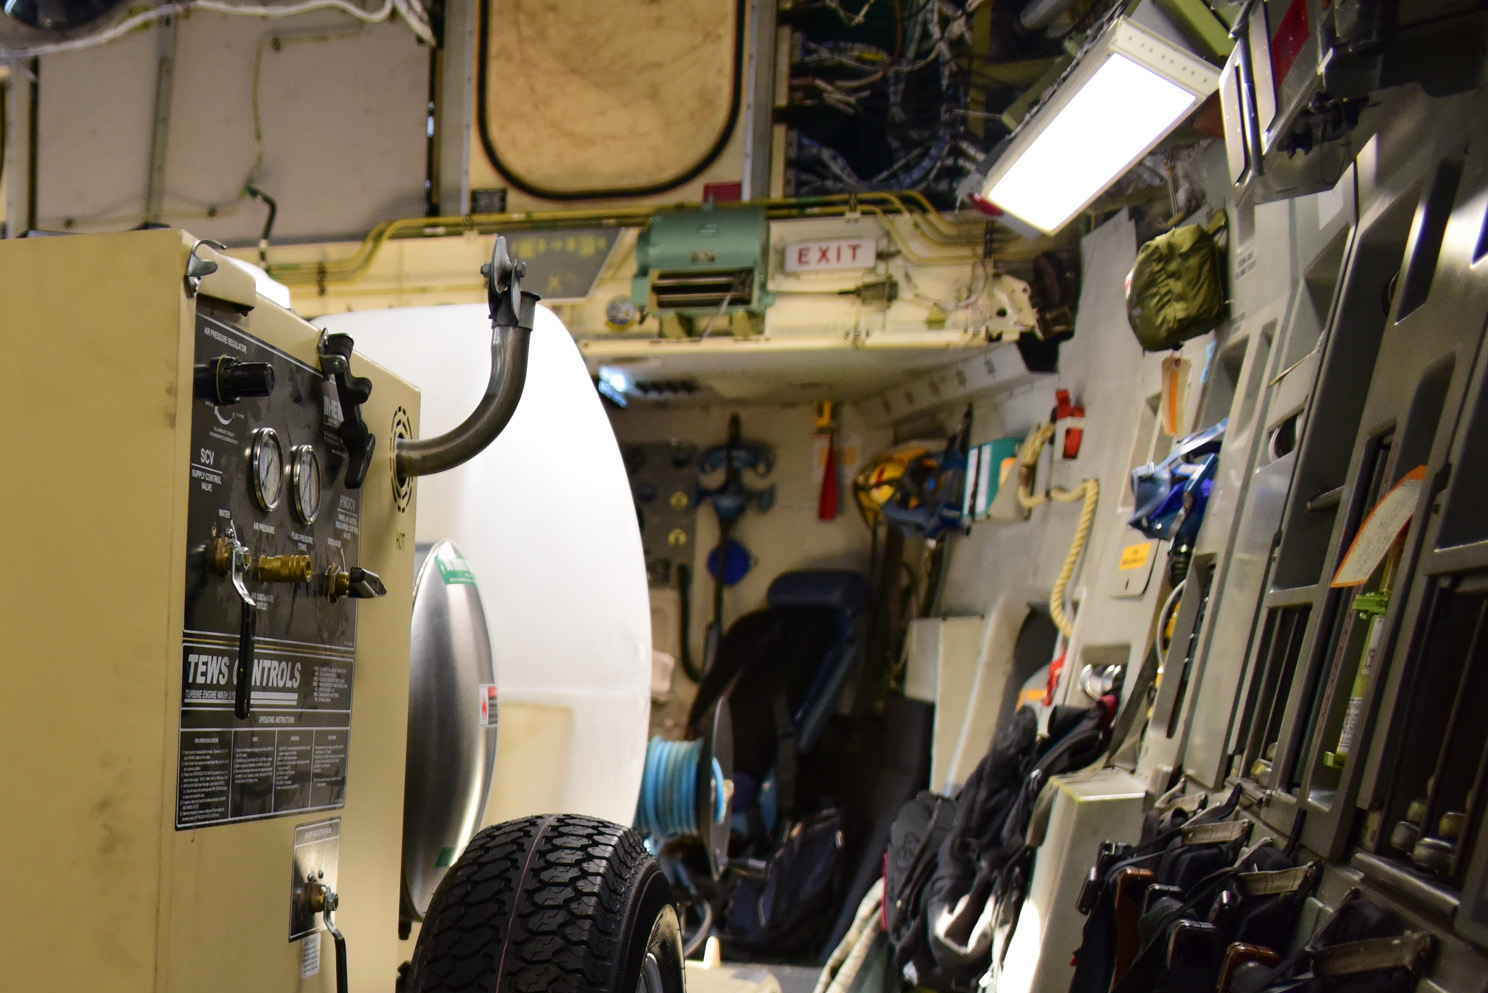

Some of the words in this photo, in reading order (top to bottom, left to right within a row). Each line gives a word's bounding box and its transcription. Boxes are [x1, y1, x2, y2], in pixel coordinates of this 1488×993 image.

[798, 244, 862, 264] EXIT
[200, 448, 214, 465] SCV
[192, 469, 205, 479] SUPPLY
[206, 473, 221, 484] CONTROL
[201, 482, 212, 492] VALVE
[219, 509, 230, 518] WATER
[259, 523, 275, 534] PRESSURE
[396, 530, 405, 552] HOT
[188, 654, 230, 685] TEWS
[233, 658, 301, 688] NTROLS
[185, 690, 202, 699] TURBINE
[203, 690, 217, 699] ENGINE
[218, 691, 228, 699] WASH
